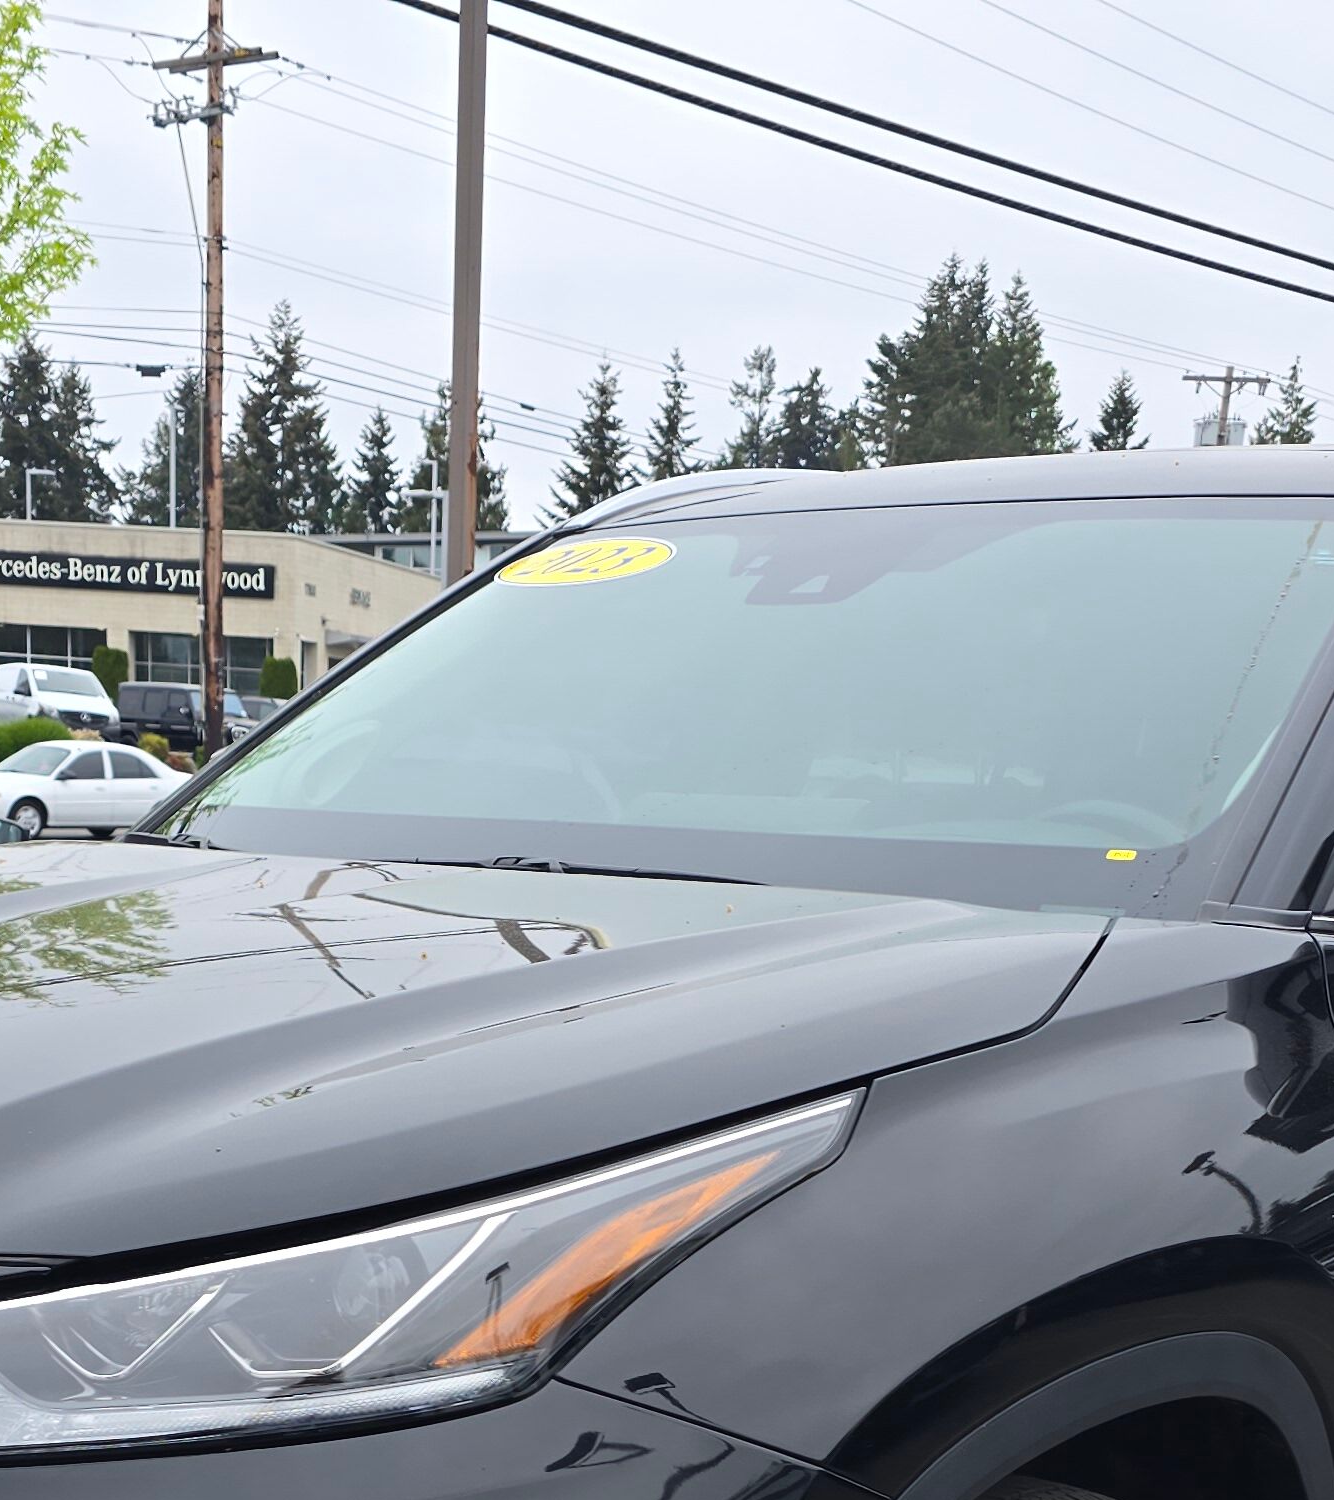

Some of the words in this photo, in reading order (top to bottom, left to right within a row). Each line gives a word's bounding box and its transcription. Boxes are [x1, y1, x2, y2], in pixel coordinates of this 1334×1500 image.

[512, 546, 657, 577] 2023
[127, 563, 150, 585] of
[154, 562, 266, 592] Lynood
